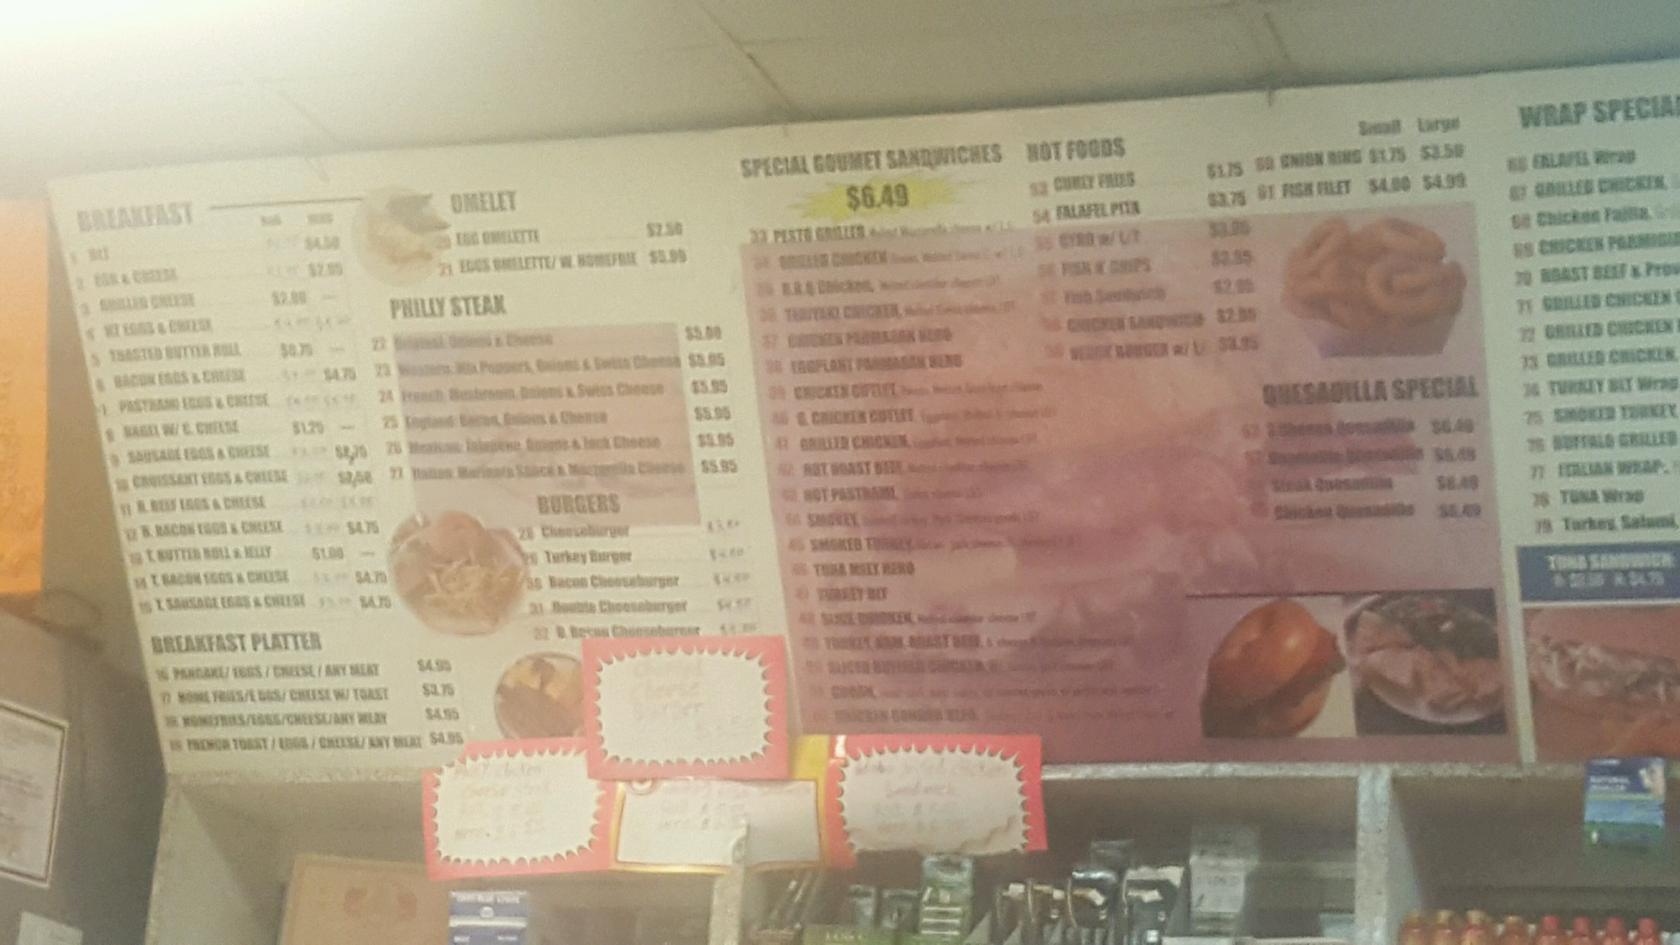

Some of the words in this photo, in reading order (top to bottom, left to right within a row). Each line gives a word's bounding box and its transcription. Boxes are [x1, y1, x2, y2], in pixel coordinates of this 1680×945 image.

[1520, 101, 1588, 129] WRAP
[1593, 95, 1680, 123] SPECIA
[1027, 141, 1061, 162] HOT
[1066, 136, 1126, 161] FOODS
[740, 154, 810, 178] SPECIAL
[846, 183, 909, 211] $6.49
[389, 297, 446, 319] PHILLY
[449, 294, 507, 317] STEAK
[1391, 376, 1479, 401] SPECIAL
[537, 493, 621, 515] BURGERS
[151, 634, 246, 654] BREAKFAST
[252, 632, 322, 652] PLATTER
